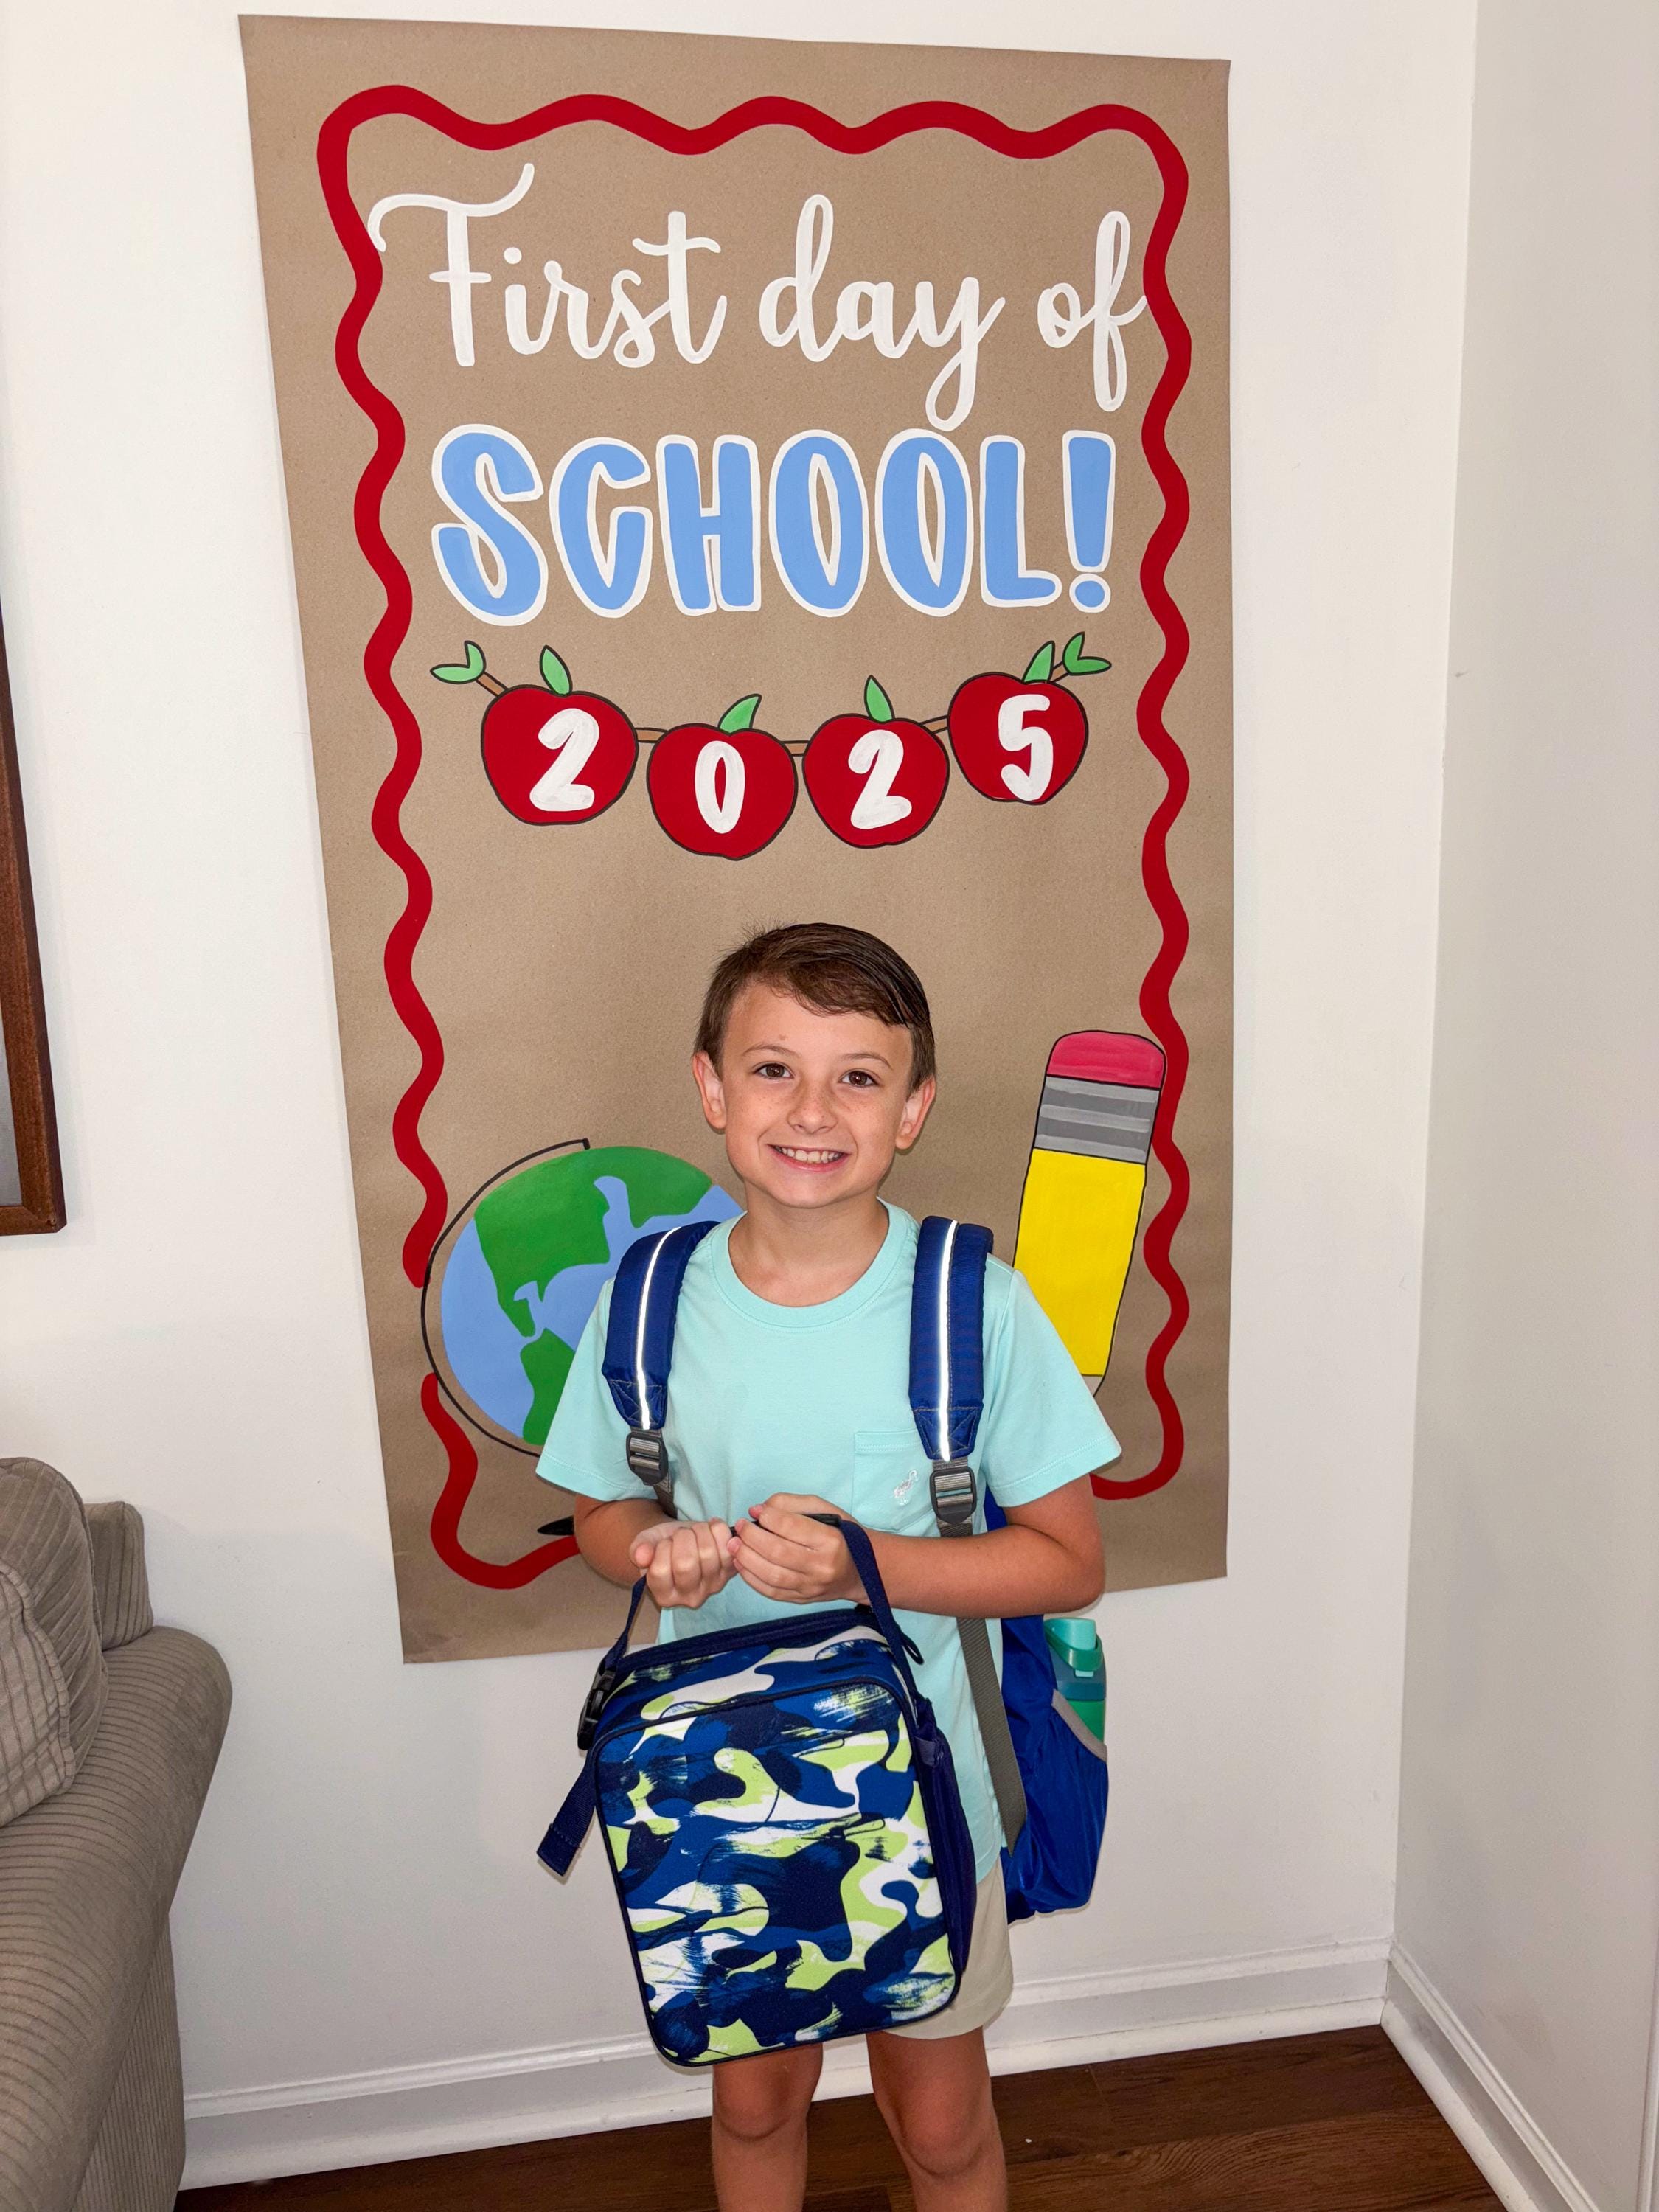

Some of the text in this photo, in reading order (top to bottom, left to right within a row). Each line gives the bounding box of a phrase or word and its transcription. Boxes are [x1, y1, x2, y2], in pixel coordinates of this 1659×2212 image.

[367, 163, 1147, 431] First day of
[431, 423, 1116, 626] SCHOOL!
